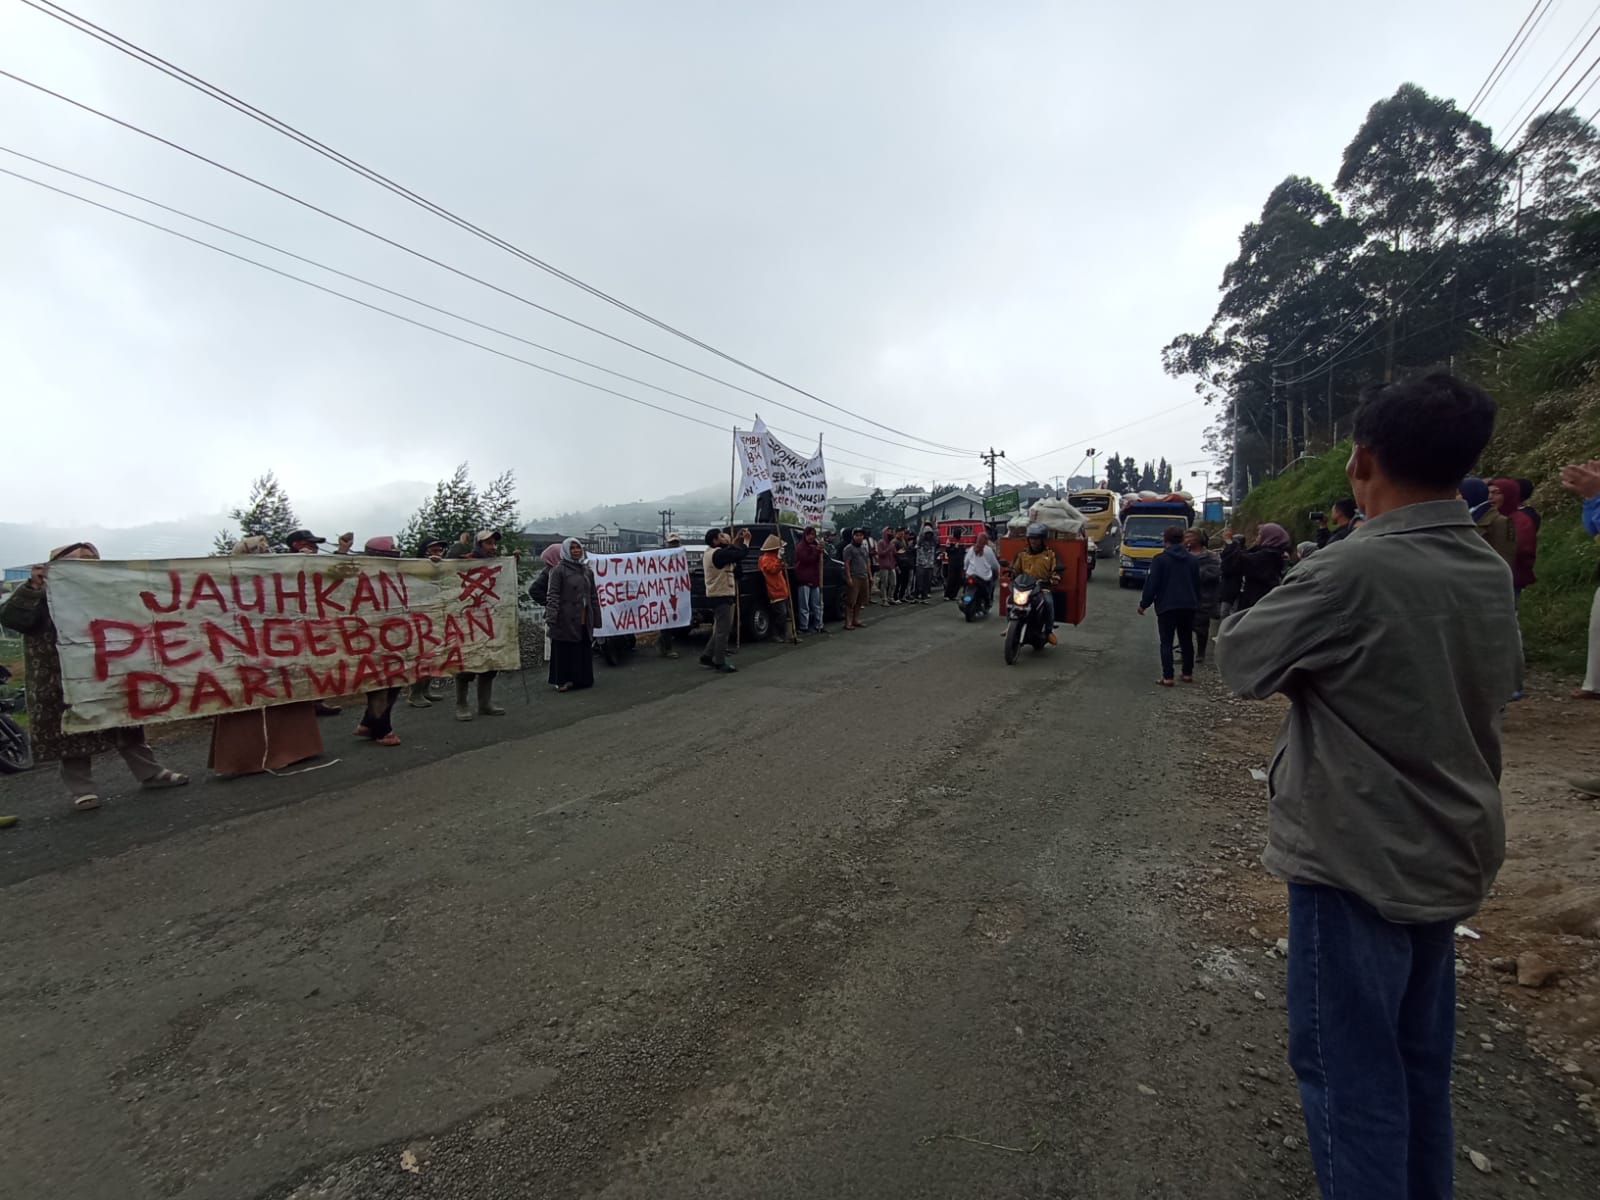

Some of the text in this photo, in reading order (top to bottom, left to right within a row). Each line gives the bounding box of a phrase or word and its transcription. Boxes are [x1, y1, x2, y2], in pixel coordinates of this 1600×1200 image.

[596, 555, 686, 577] UTAMAKAN
[140, 570, 408, 616] JAUHKAN
[610, 594, 678, 630] WARGA!
[88, 607, 495, 681] PENGEBORAN
[127, 663, 291, 718] DARI
